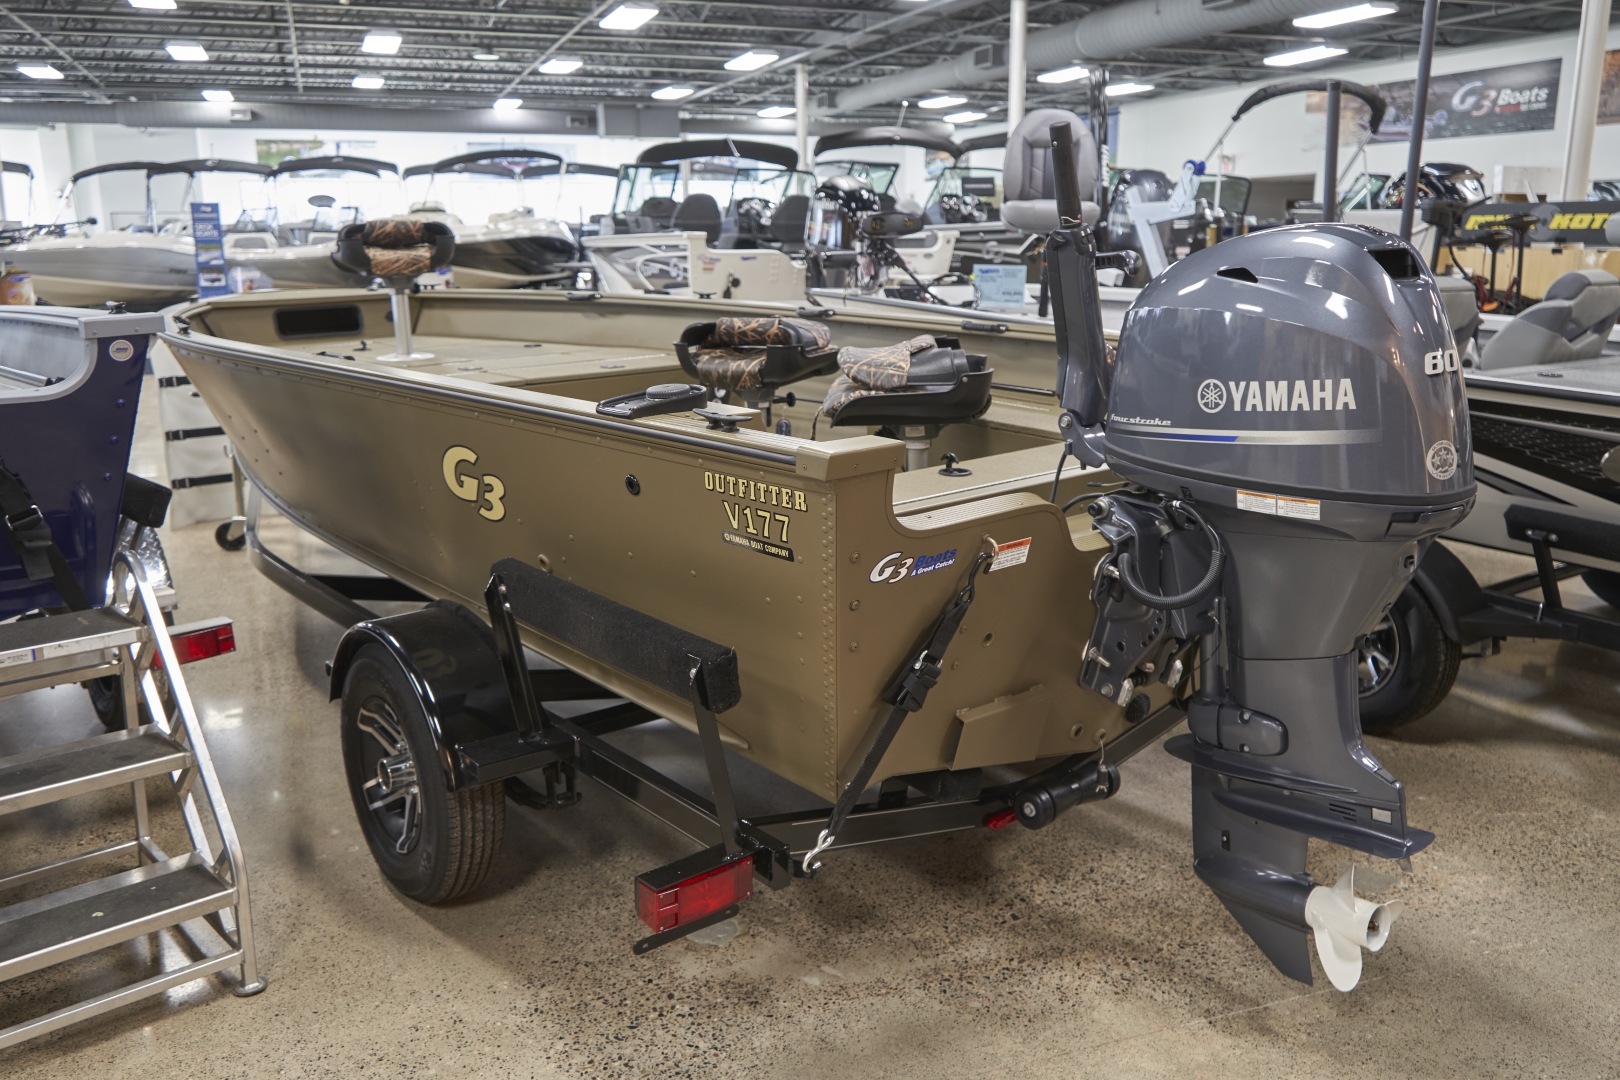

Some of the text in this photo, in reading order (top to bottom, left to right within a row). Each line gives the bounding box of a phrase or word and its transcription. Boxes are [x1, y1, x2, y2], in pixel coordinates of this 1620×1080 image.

[1451, 80, 1549, 117] G3 Boats
[1549, 213, 1612, 230] KOT
[1424, 350, 1458, 375] 60
[1228, 378, 1357, 412] YAMAHA
[442, 444, 506, 523] G3
[704, 471, 808, 513] OUTFITTER
[722, 500, 789, 543] V177
[730, 534, 789, 558] YAMAHA BOAT COMPANY
[869, 549, 957, 584] G3 Boats
[911, 569, 916, 577] A
[917, 565, 934, 574] Great
